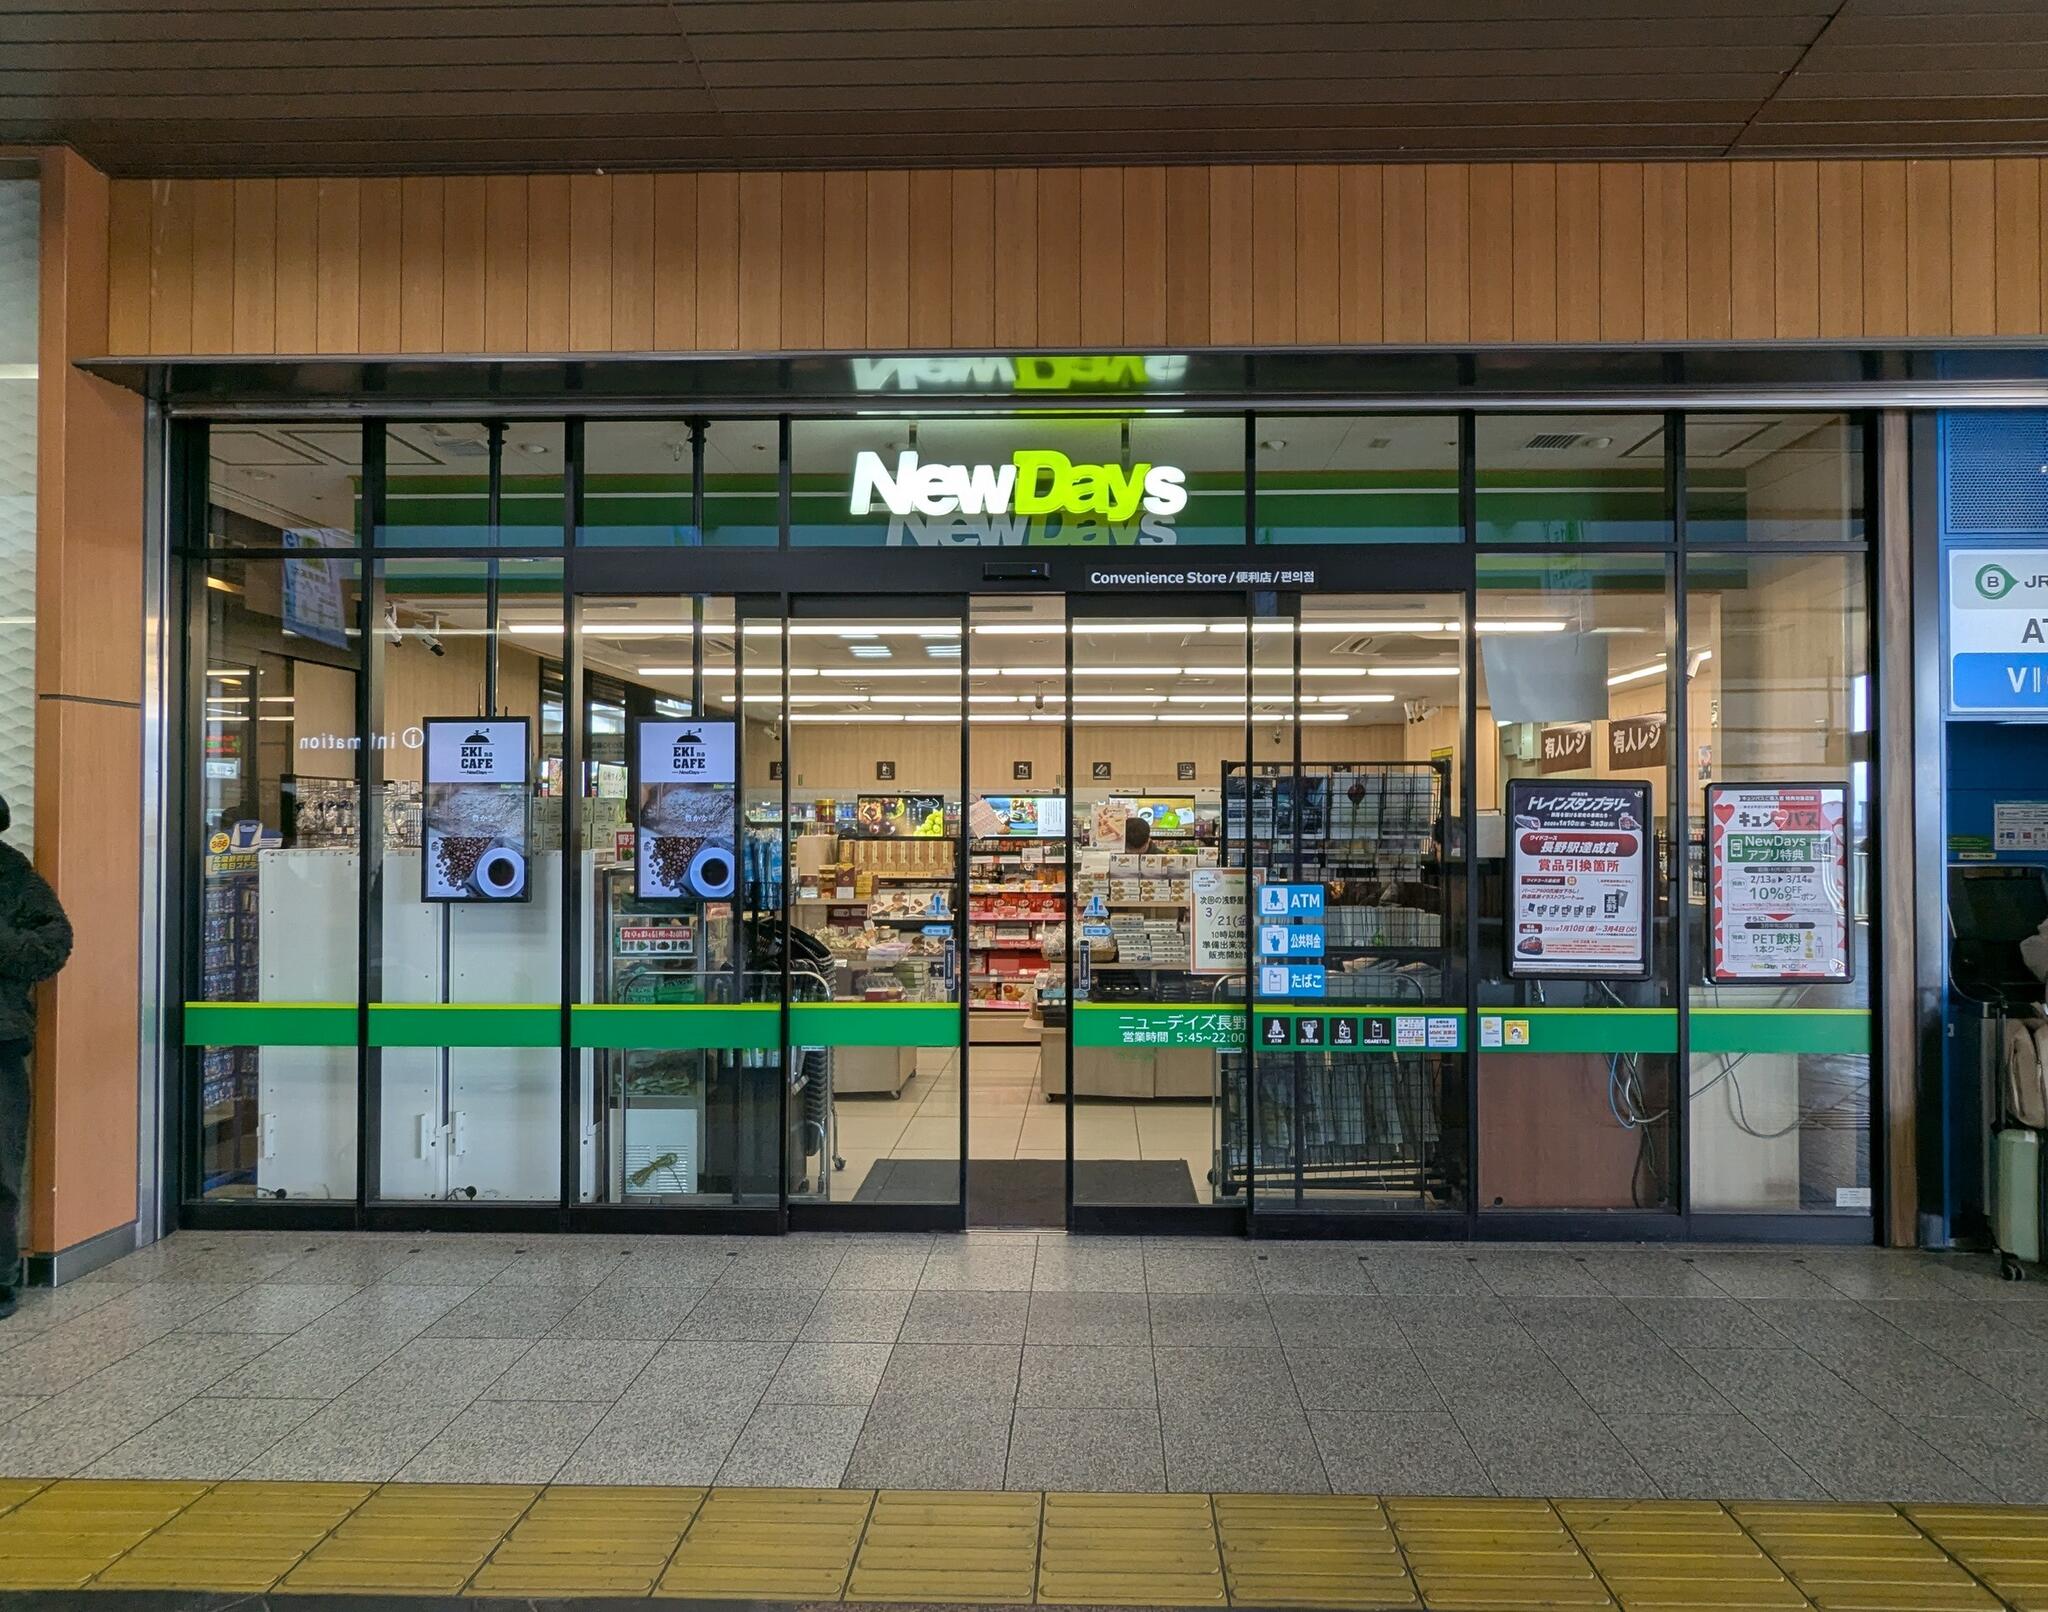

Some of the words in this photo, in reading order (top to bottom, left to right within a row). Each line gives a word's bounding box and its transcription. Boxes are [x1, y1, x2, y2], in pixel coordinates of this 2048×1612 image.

[850, 449, 1188, 522] NewDays
[1091, 570, 1184, 585] Convenience
[1187, 570, 1227, 585] Store
[1236, 571, 1272, 584] 便利店
[1614, 722, 1660, 754] 有人レジ
[461, 747, 482, 757] EKI
[673, 747, 694, 757] EKI
[1545, 732, 1587, 759] 有人レジ
[461, 758, 493, 769] CAFE
[673, 758, 705, 769] CAFE
[1528, 796, 1631, 811] トレインスタンプラリー
[1541, 842, 1618, 854] 長野駅達成賞
[1745, 836, 1806, 847] NewDays
[1747, 849, 1804, 861] アプリ特典
[1538, 859, 1619, 873] 賞品引換箇所
[1749, 887, 1784, 900] 10%
[1785, 893, 1817, 901] クーポン
[1291, 893, 1320, 908] ATM
[1291, 934, 1321, 949] 公共料金
[1752, 933, 1801, 945] PET飲料
[1291, 974, 1322, 988] たばこ
[1118, 1015, 1246, 1030] ニューデイズ長野
[1122, 1032, 1168, 1043] 営業時間
